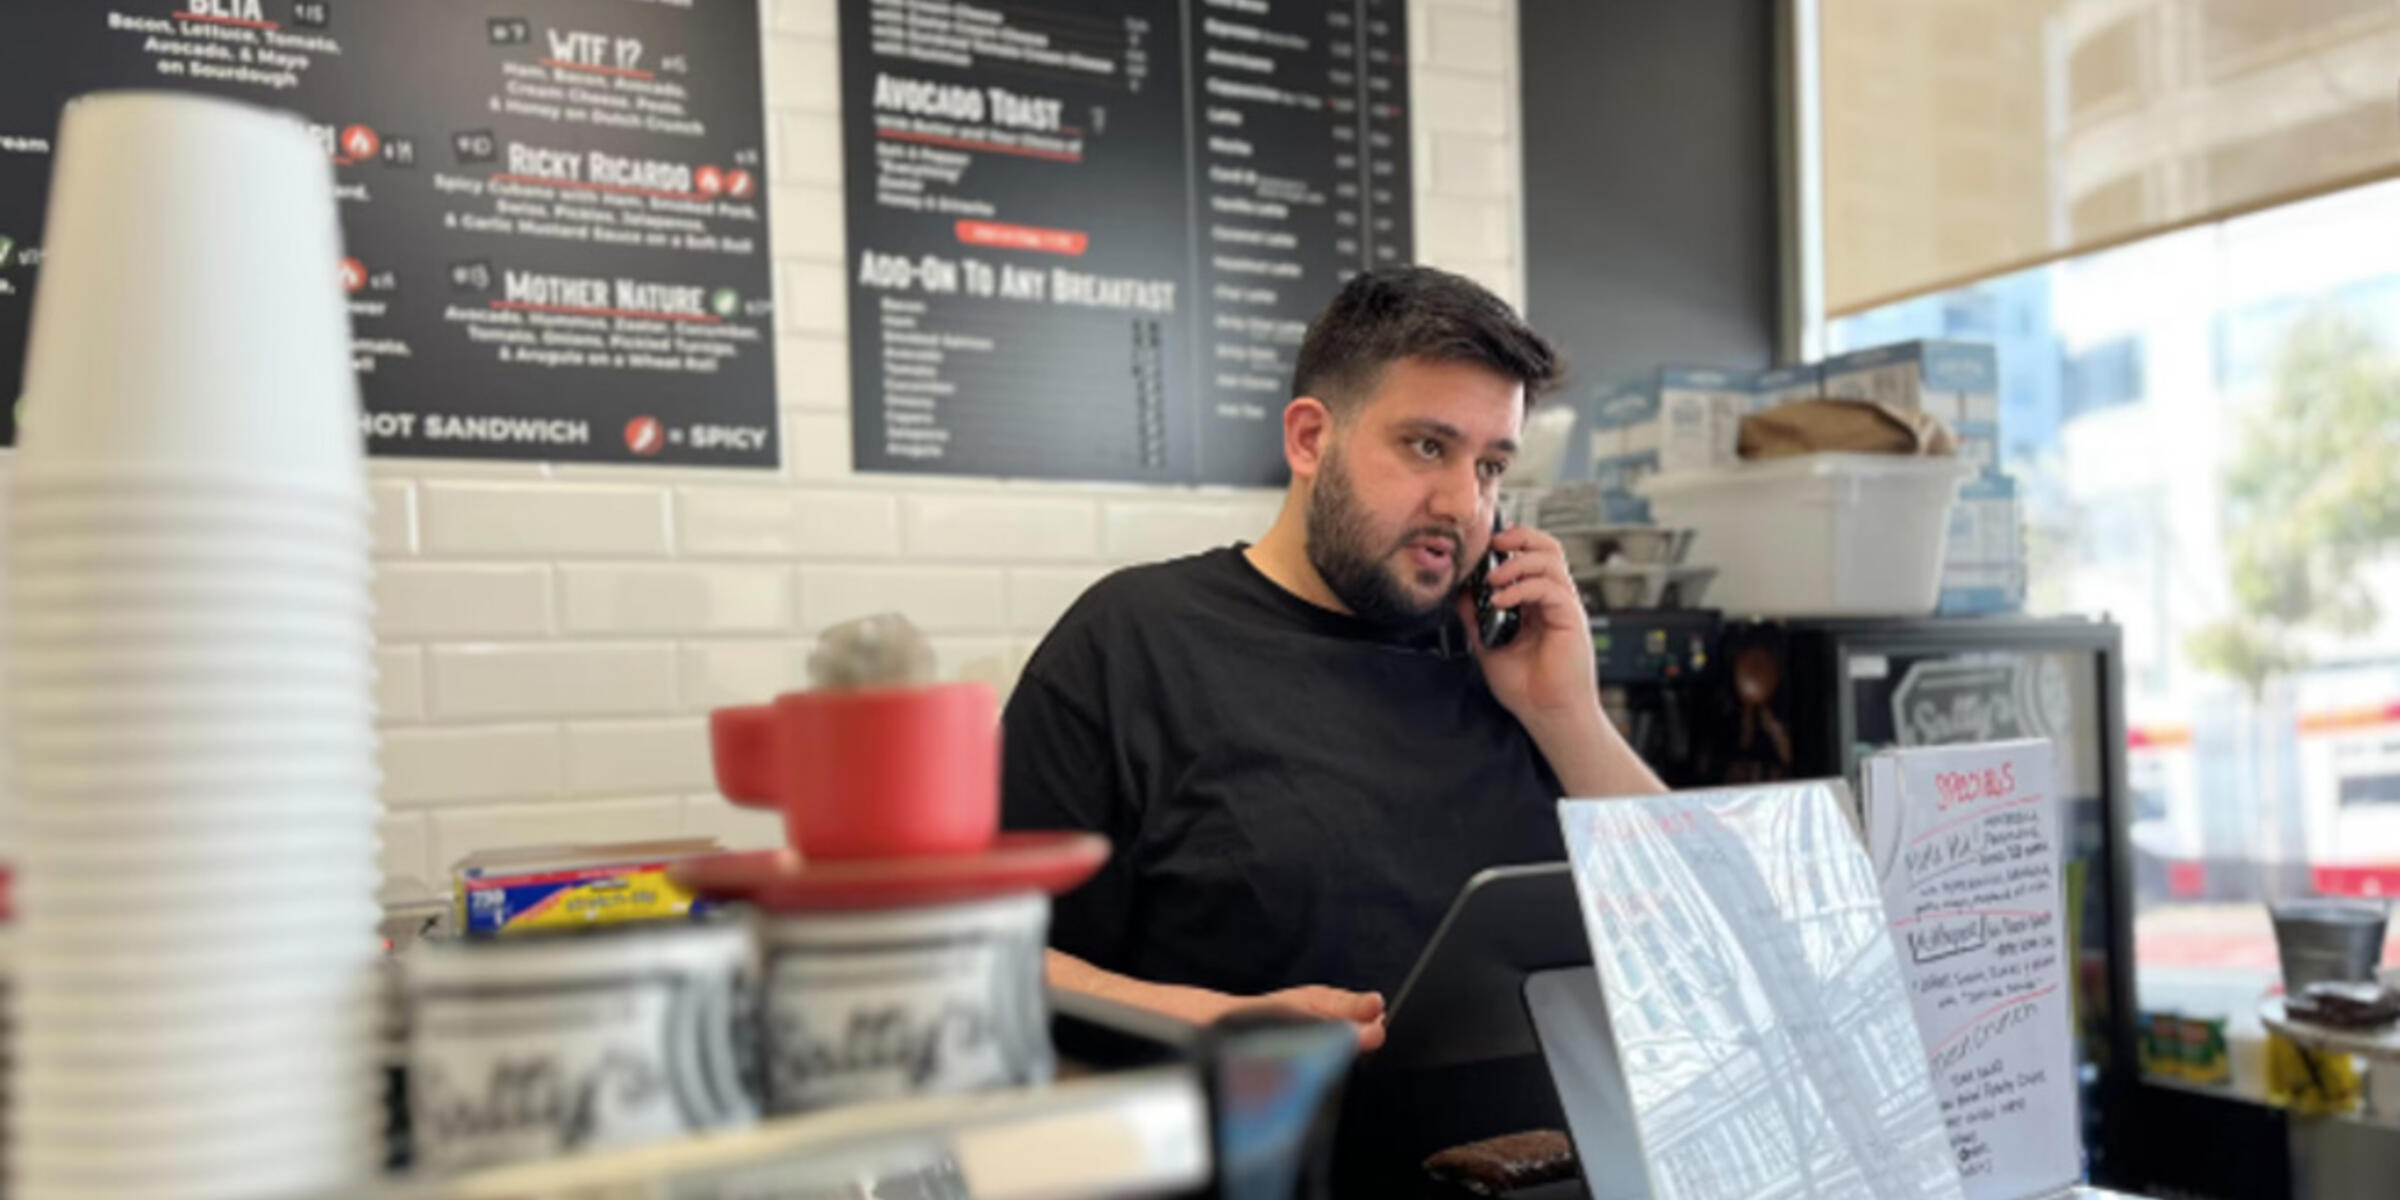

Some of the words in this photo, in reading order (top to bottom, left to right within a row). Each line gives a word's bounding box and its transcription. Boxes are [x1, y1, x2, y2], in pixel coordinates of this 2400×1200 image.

[180, 20, 260, 45] Lettuce,
[265, 30, 342, 55] Tomato,
[547, 28, 608, 67] WTF
[157, 60, 185, 76] on
[190, 61, 299, 89] Sourdough
[258, 50, 310, 71] Mayo
[507, 80, 562, 100] Cream
[873, 72, 984, 123] AVOCADO
[987, 86, 1063, 132] TOAST
[506, 99, 560, 122] Honey
[566, 108, 588, 122] on
[591, 109, 642, 128] Dutch
[647, 116, 704, 137] Crunch
[507, 143, 582, 182] RICKY
[589, 151, 692, 192] RICARDO
[433, 173, 483, 195] Spicy
[559, 186, 600, 203] with
[649, 197, 714, 216] Smoked
[462, 214, 512, 232] Garlic
[517, 219, 590, 240] Mustard
[504, 271, 610, 308] MOTHER
[615, 278, 707, 316] NATURE
[858, 249, 957, 293] ADD-ON
[961, 257, 996, 298] TO
[999, 263, 1046, 300] ANY
[1051, 267, 1177, 313] BREAKFAST
[444, 305, 523, 326] Avocado,
[529, 310, 609, 331] Hummus,
[674, 320, 761, 342] Cucumber,
[468, 325, 538, 346] Tomato,
[542, 331, 604, 350] Onions,
[609, 333, 671, 353] Pickled
[675, 338, 738, 359] Turnips,
[514, 348, 585, 370] Arugula
[589, 353, 610, 367] on
[628, 353, 681, 371] Wheat
[685, 356, 718, 373] Roll
[358, 412, 416, 437] HOT
[424, 415, 590, 444] SANDWICH
[690, 426, 768, 450] SPICY
